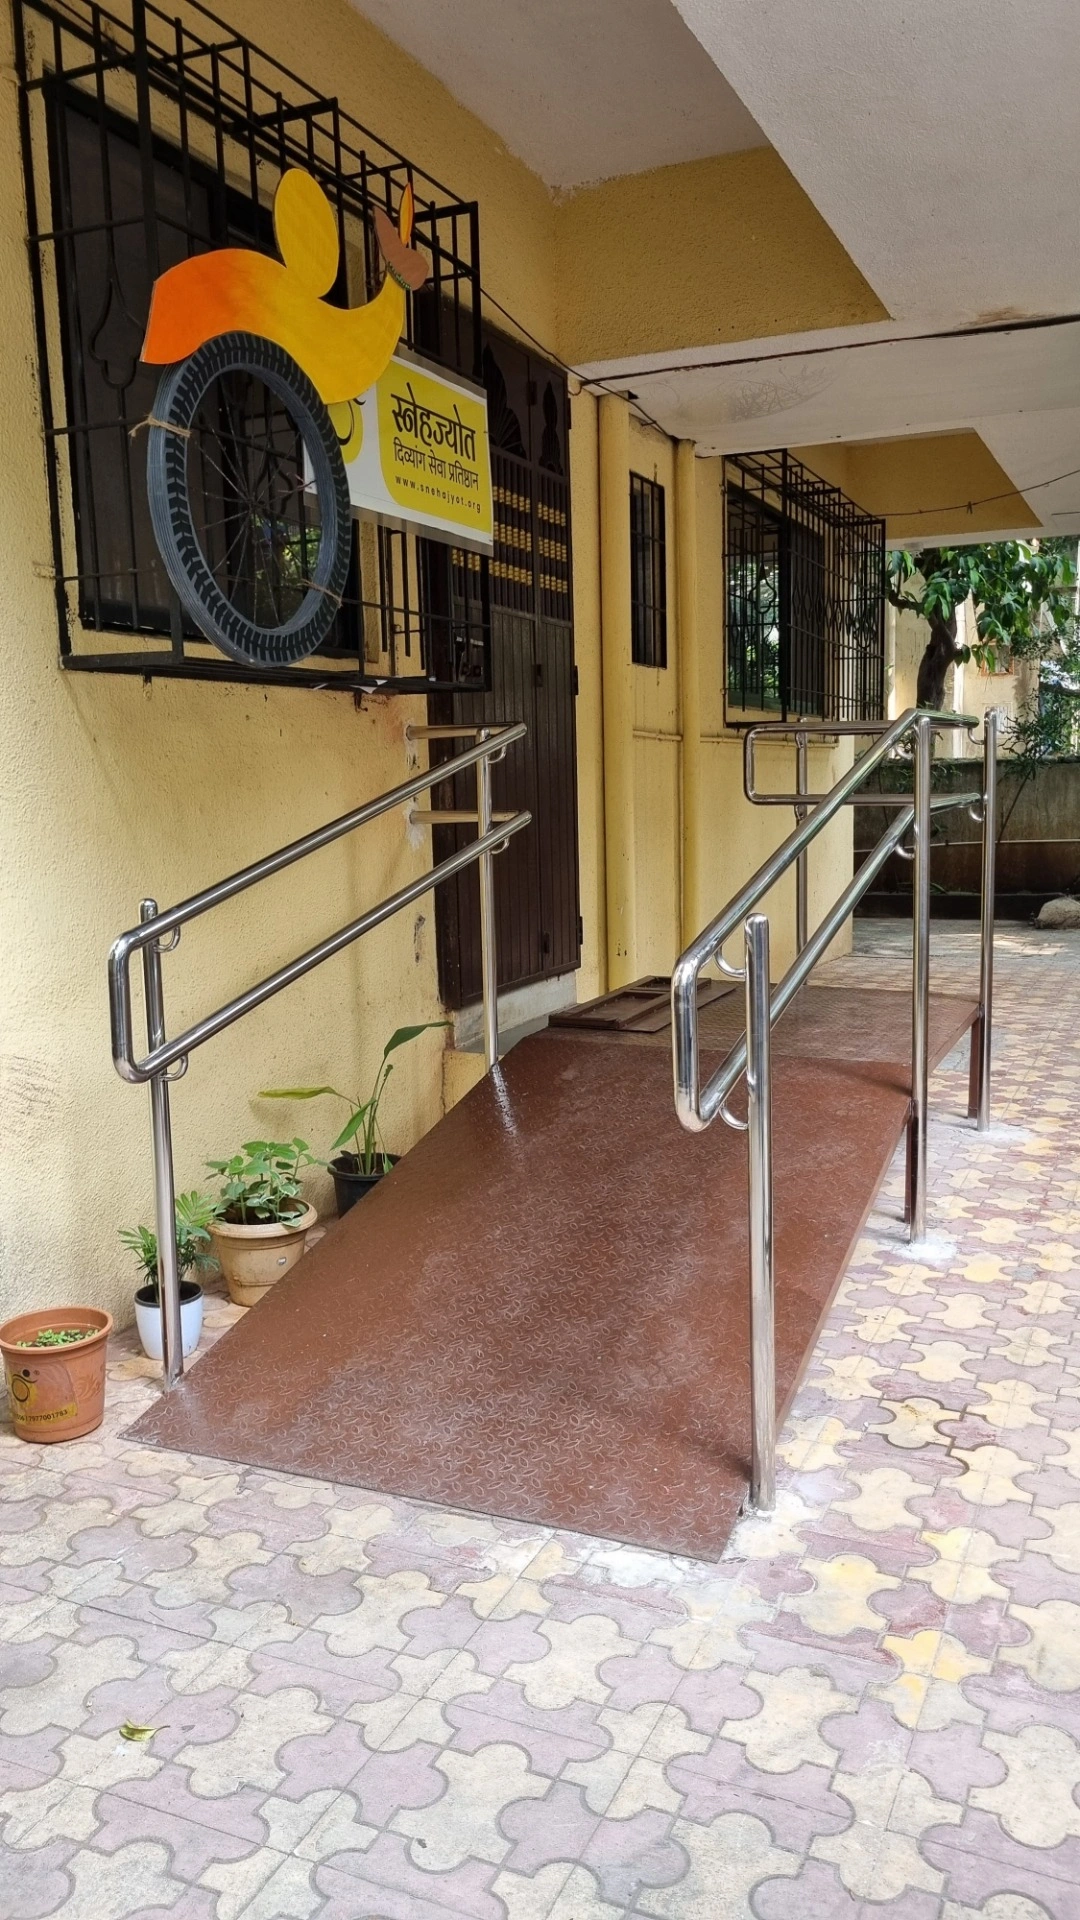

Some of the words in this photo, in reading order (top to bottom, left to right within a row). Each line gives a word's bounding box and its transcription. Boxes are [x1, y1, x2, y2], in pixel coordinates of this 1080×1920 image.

[391, 382, 476, 461] स्नेहज्योत
[393, 437, 426, 471] दिव्यांग
[428, 449, 446, 478] सेवा
[448, 460, 479, 491] प्रतिष्ठान
[395, 475, 481, 513] www.snehajyot.org
